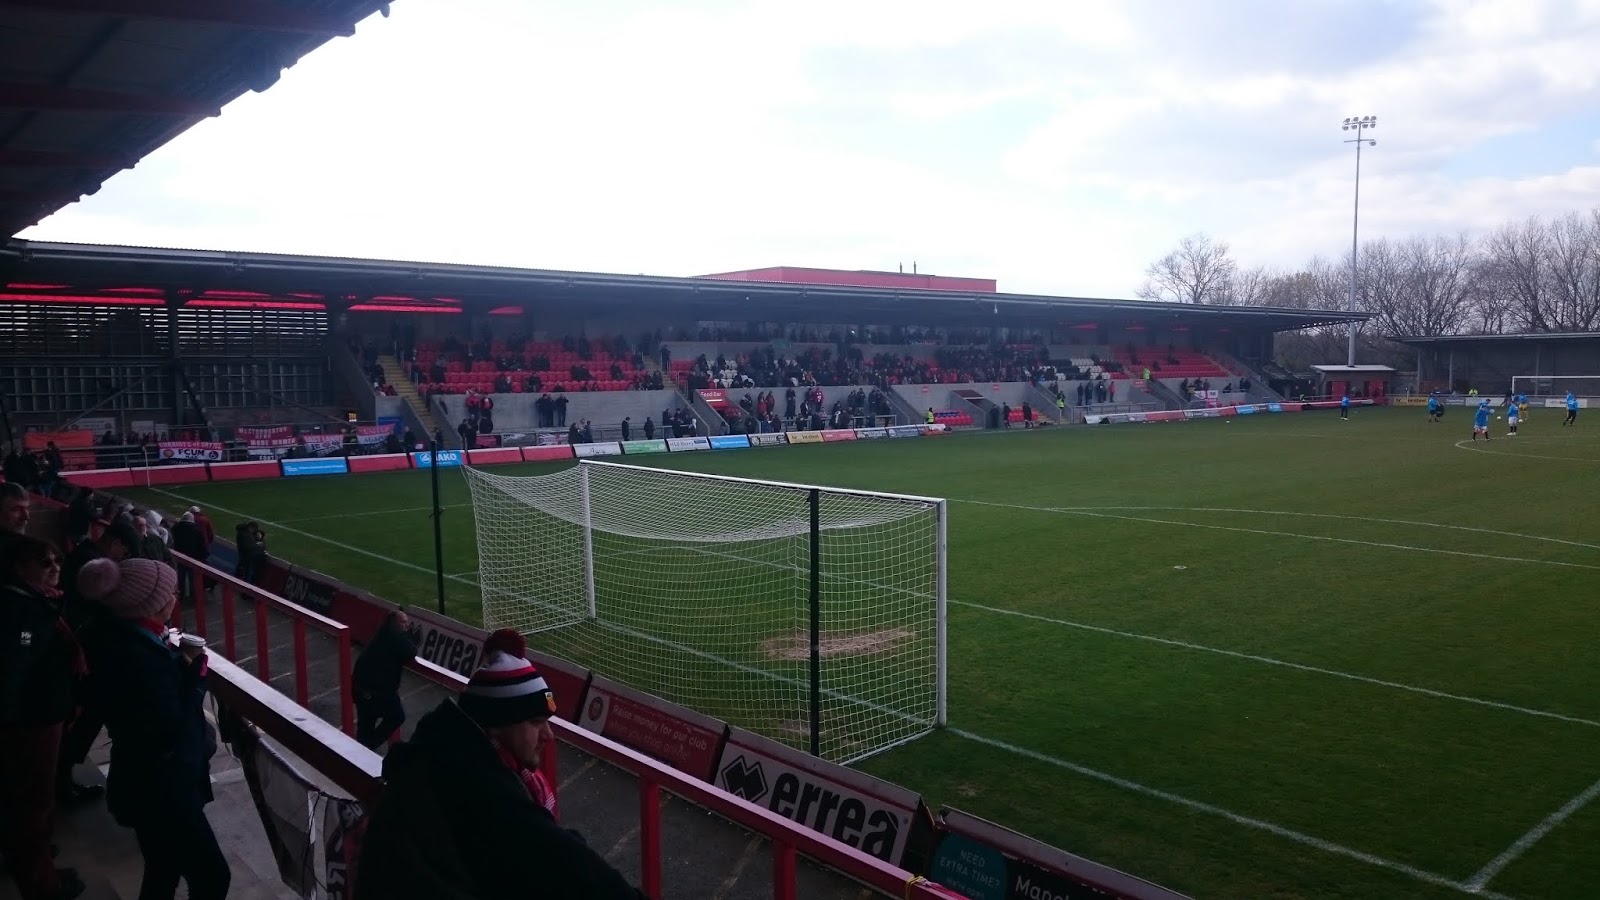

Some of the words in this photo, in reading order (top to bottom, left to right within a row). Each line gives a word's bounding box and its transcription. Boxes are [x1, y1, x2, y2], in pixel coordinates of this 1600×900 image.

[613, 704, 632, 721] Raise
[633, 714, 660, 732] money
[661, 722, 673, 736] for
[673, 730, 688, 743] our
[688, 736, 707, 751] club
[939, 856, 968, 876] EXTRA
[971, 869, 1001, 889] TIME?
[960, 849, 985, 868] NEED
[1015, 874, 1070, 900] Man
